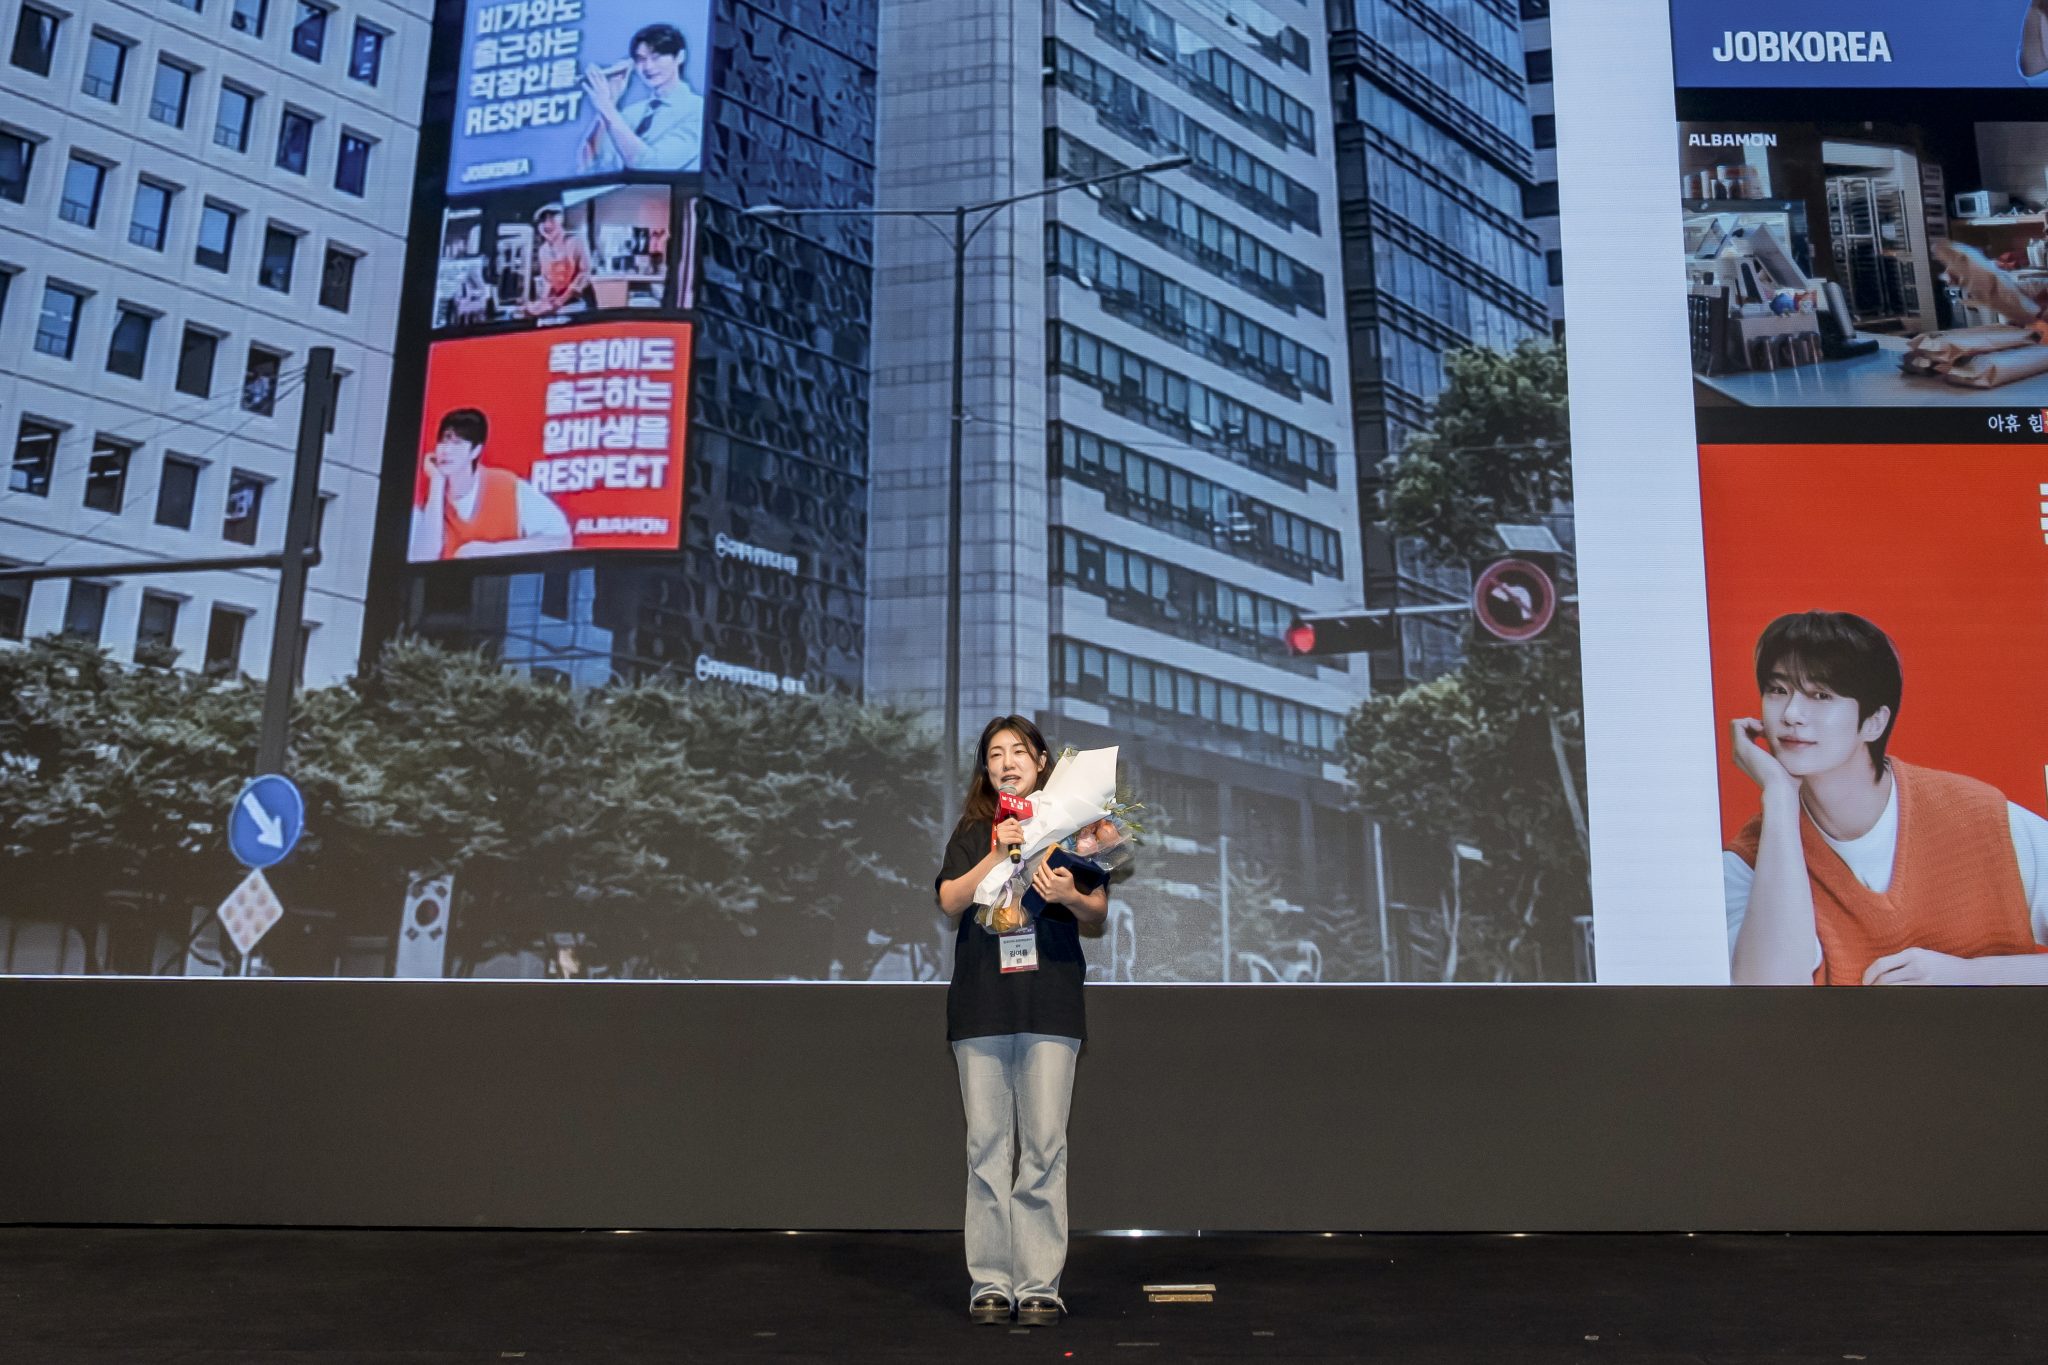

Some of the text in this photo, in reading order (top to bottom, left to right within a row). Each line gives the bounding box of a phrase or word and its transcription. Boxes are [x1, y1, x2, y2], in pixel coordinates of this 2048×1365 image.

[477, 0, 581, 33] 비가와도
[473, 27, 580, 69] 출근하는
[1712, 31, 1892, 63] JOBKOREA
[465, 91, 583, 136] RESPECT
[1688, 133, 1777, 147] ALBAMON
[549, 337, 675, 375] 폭염에도
[545, 375, 672, 416] 출근하는
[1988, 413, 2021, 433] 아휴
[531, 455, 669, 493] RESPECT
